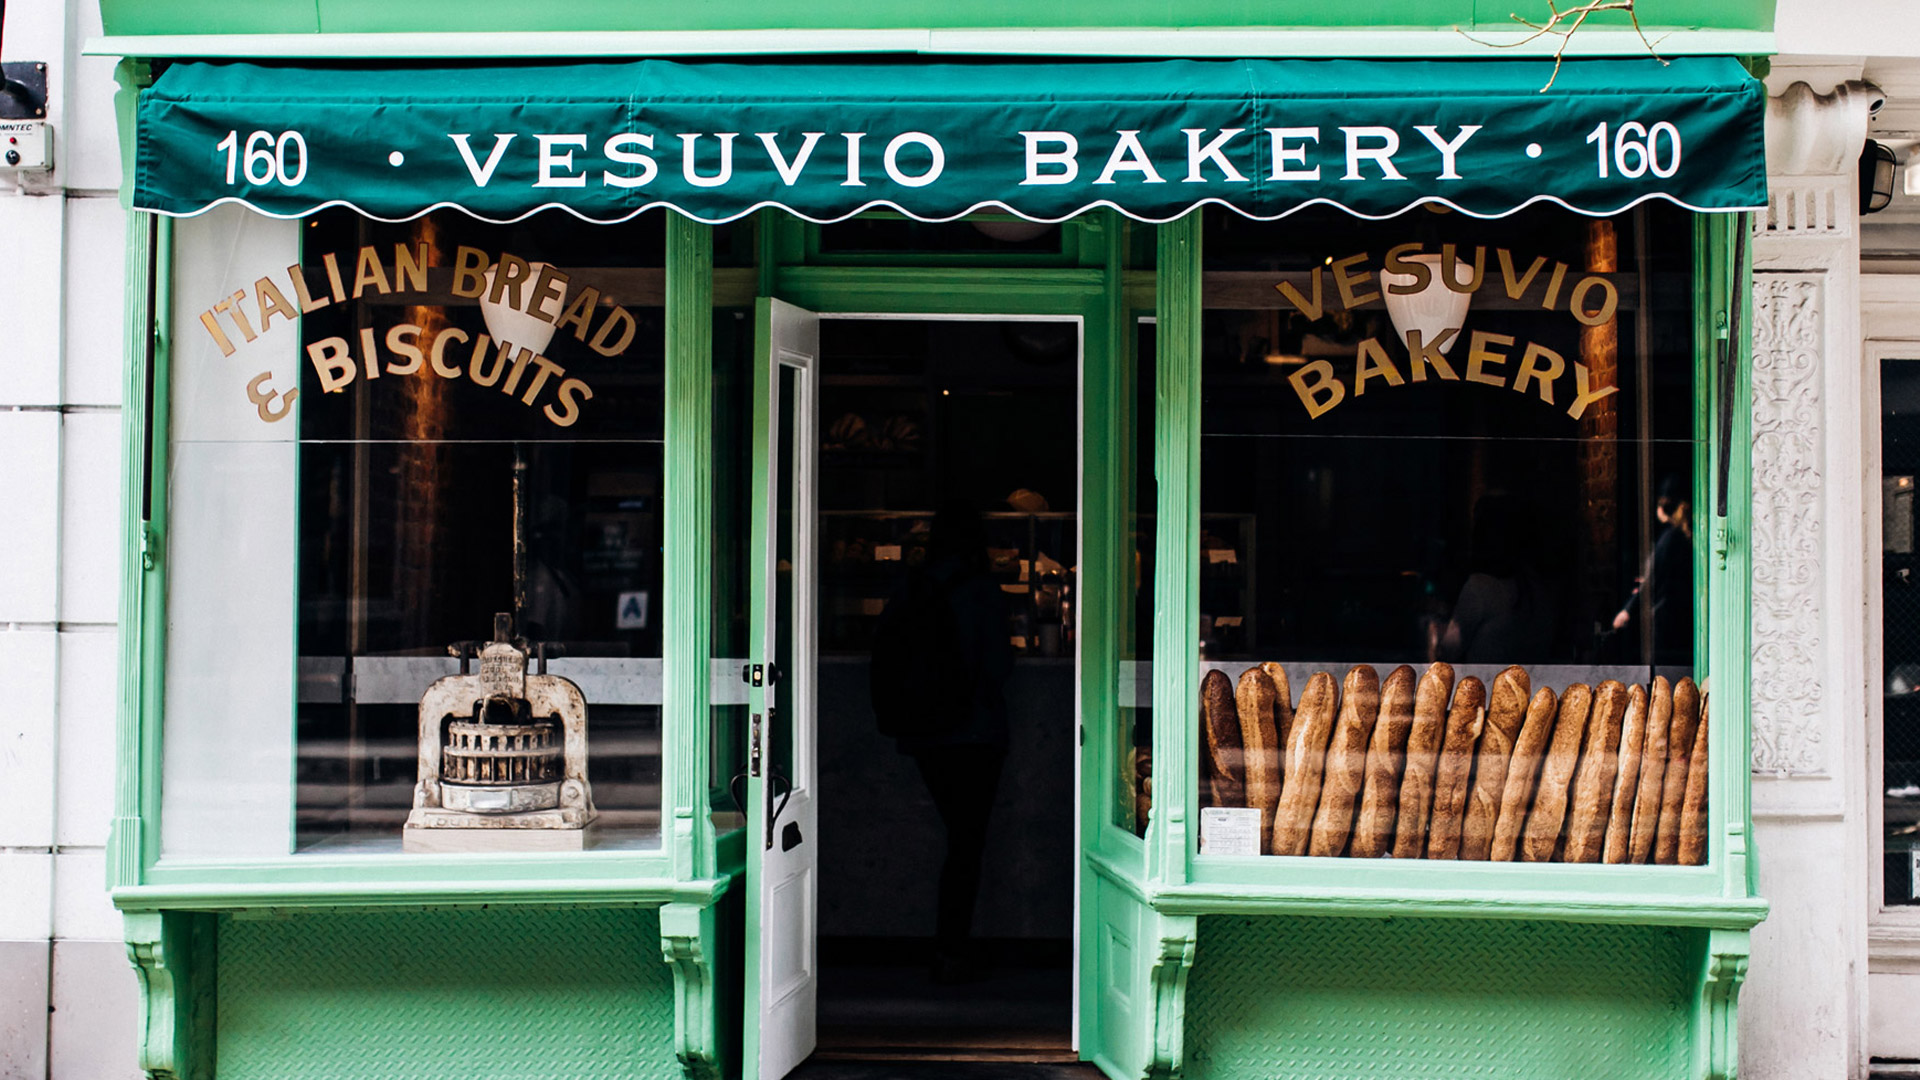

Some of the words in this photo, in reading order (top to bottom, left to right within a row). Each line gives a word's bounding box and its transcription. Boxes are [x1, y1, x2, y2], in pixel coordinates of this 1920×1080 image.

[0, 123, 32, 131] MNTEC
[217, 130, 308, 187] 160
[447, 130, 946, 188] VESUVIO
[1018, 125, 1483, 185] BAKERY
[1586, 121, 1682, 179] 160
[199, 241, 430, 357] ITALIAN
[450, 244, 637, 358] BREAD
[1274, 242, 1619, 327] VESUVIO
[245, 370, 300, 424] &
[306, 323, 594, 428] BISCUITS
[1287, 327, 1620, 421] BAKERY
[622, 595, 642, 619] A
